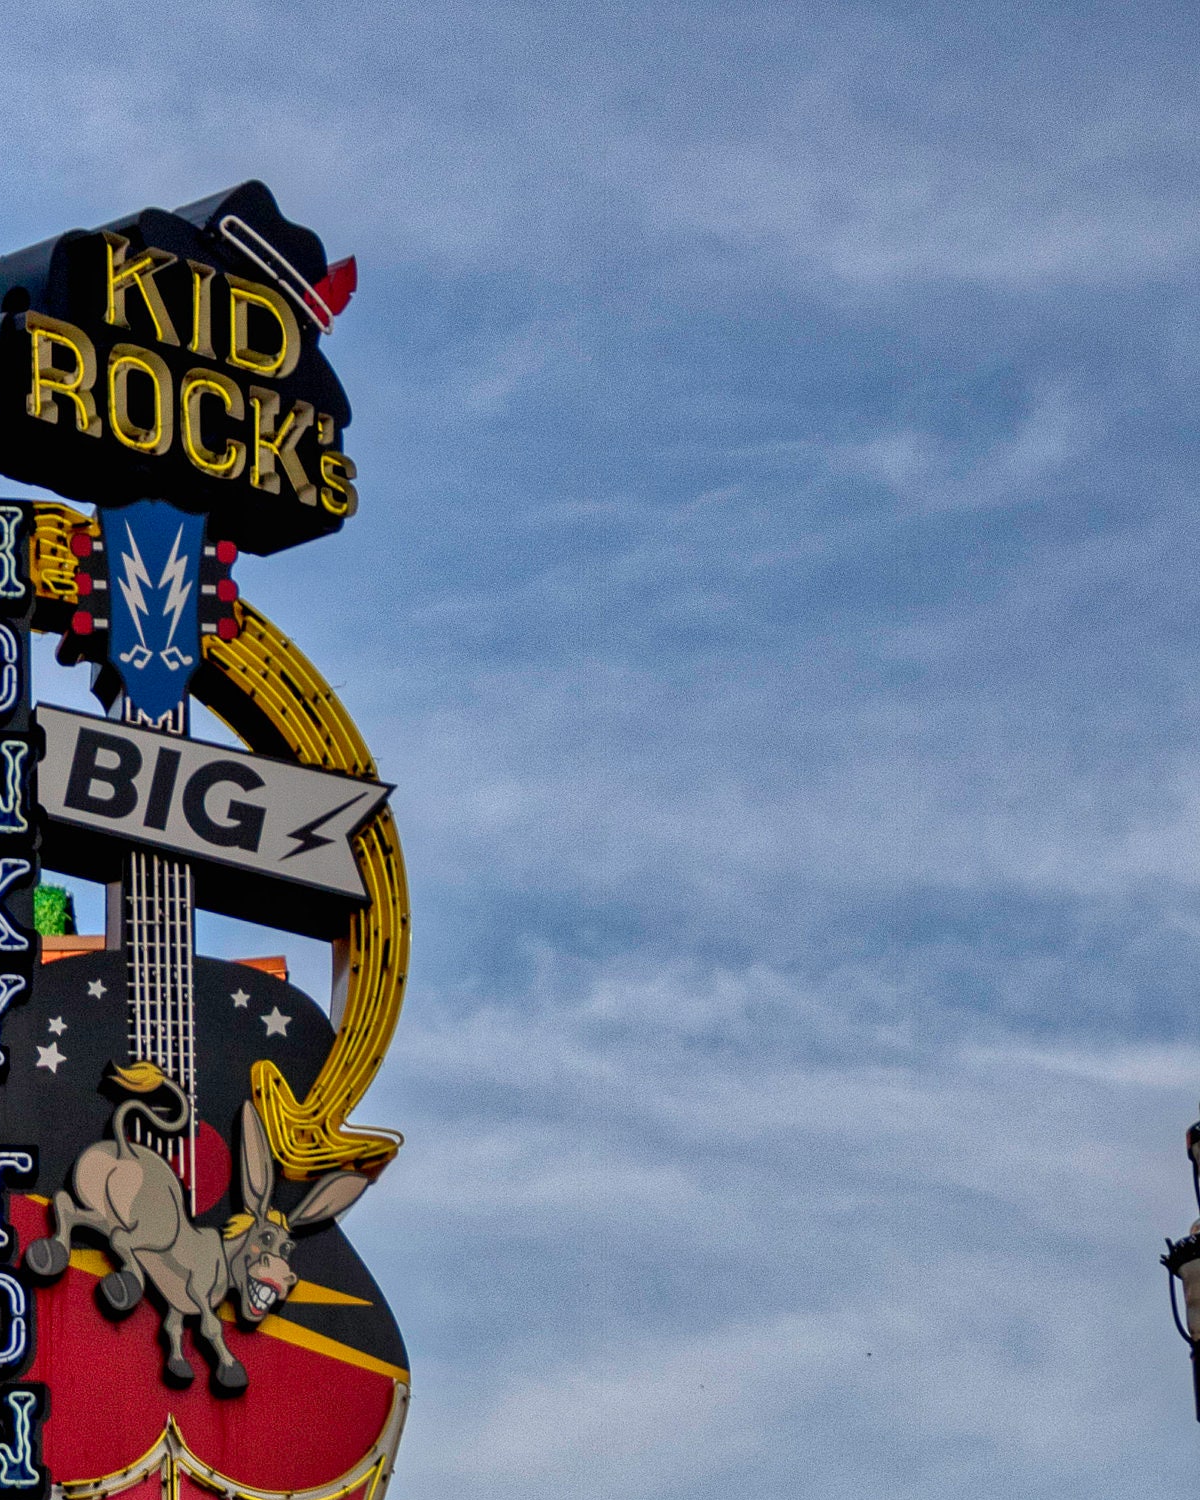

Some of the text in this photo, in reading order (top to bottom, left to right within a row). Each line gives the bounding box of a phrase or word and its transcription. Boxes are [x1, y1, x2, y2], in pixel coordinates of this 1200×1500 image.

[102, 231, 301, 380] KID
[24, 309, 358, 519] ROCK'S
[63, 726, 269, 853] BIG
